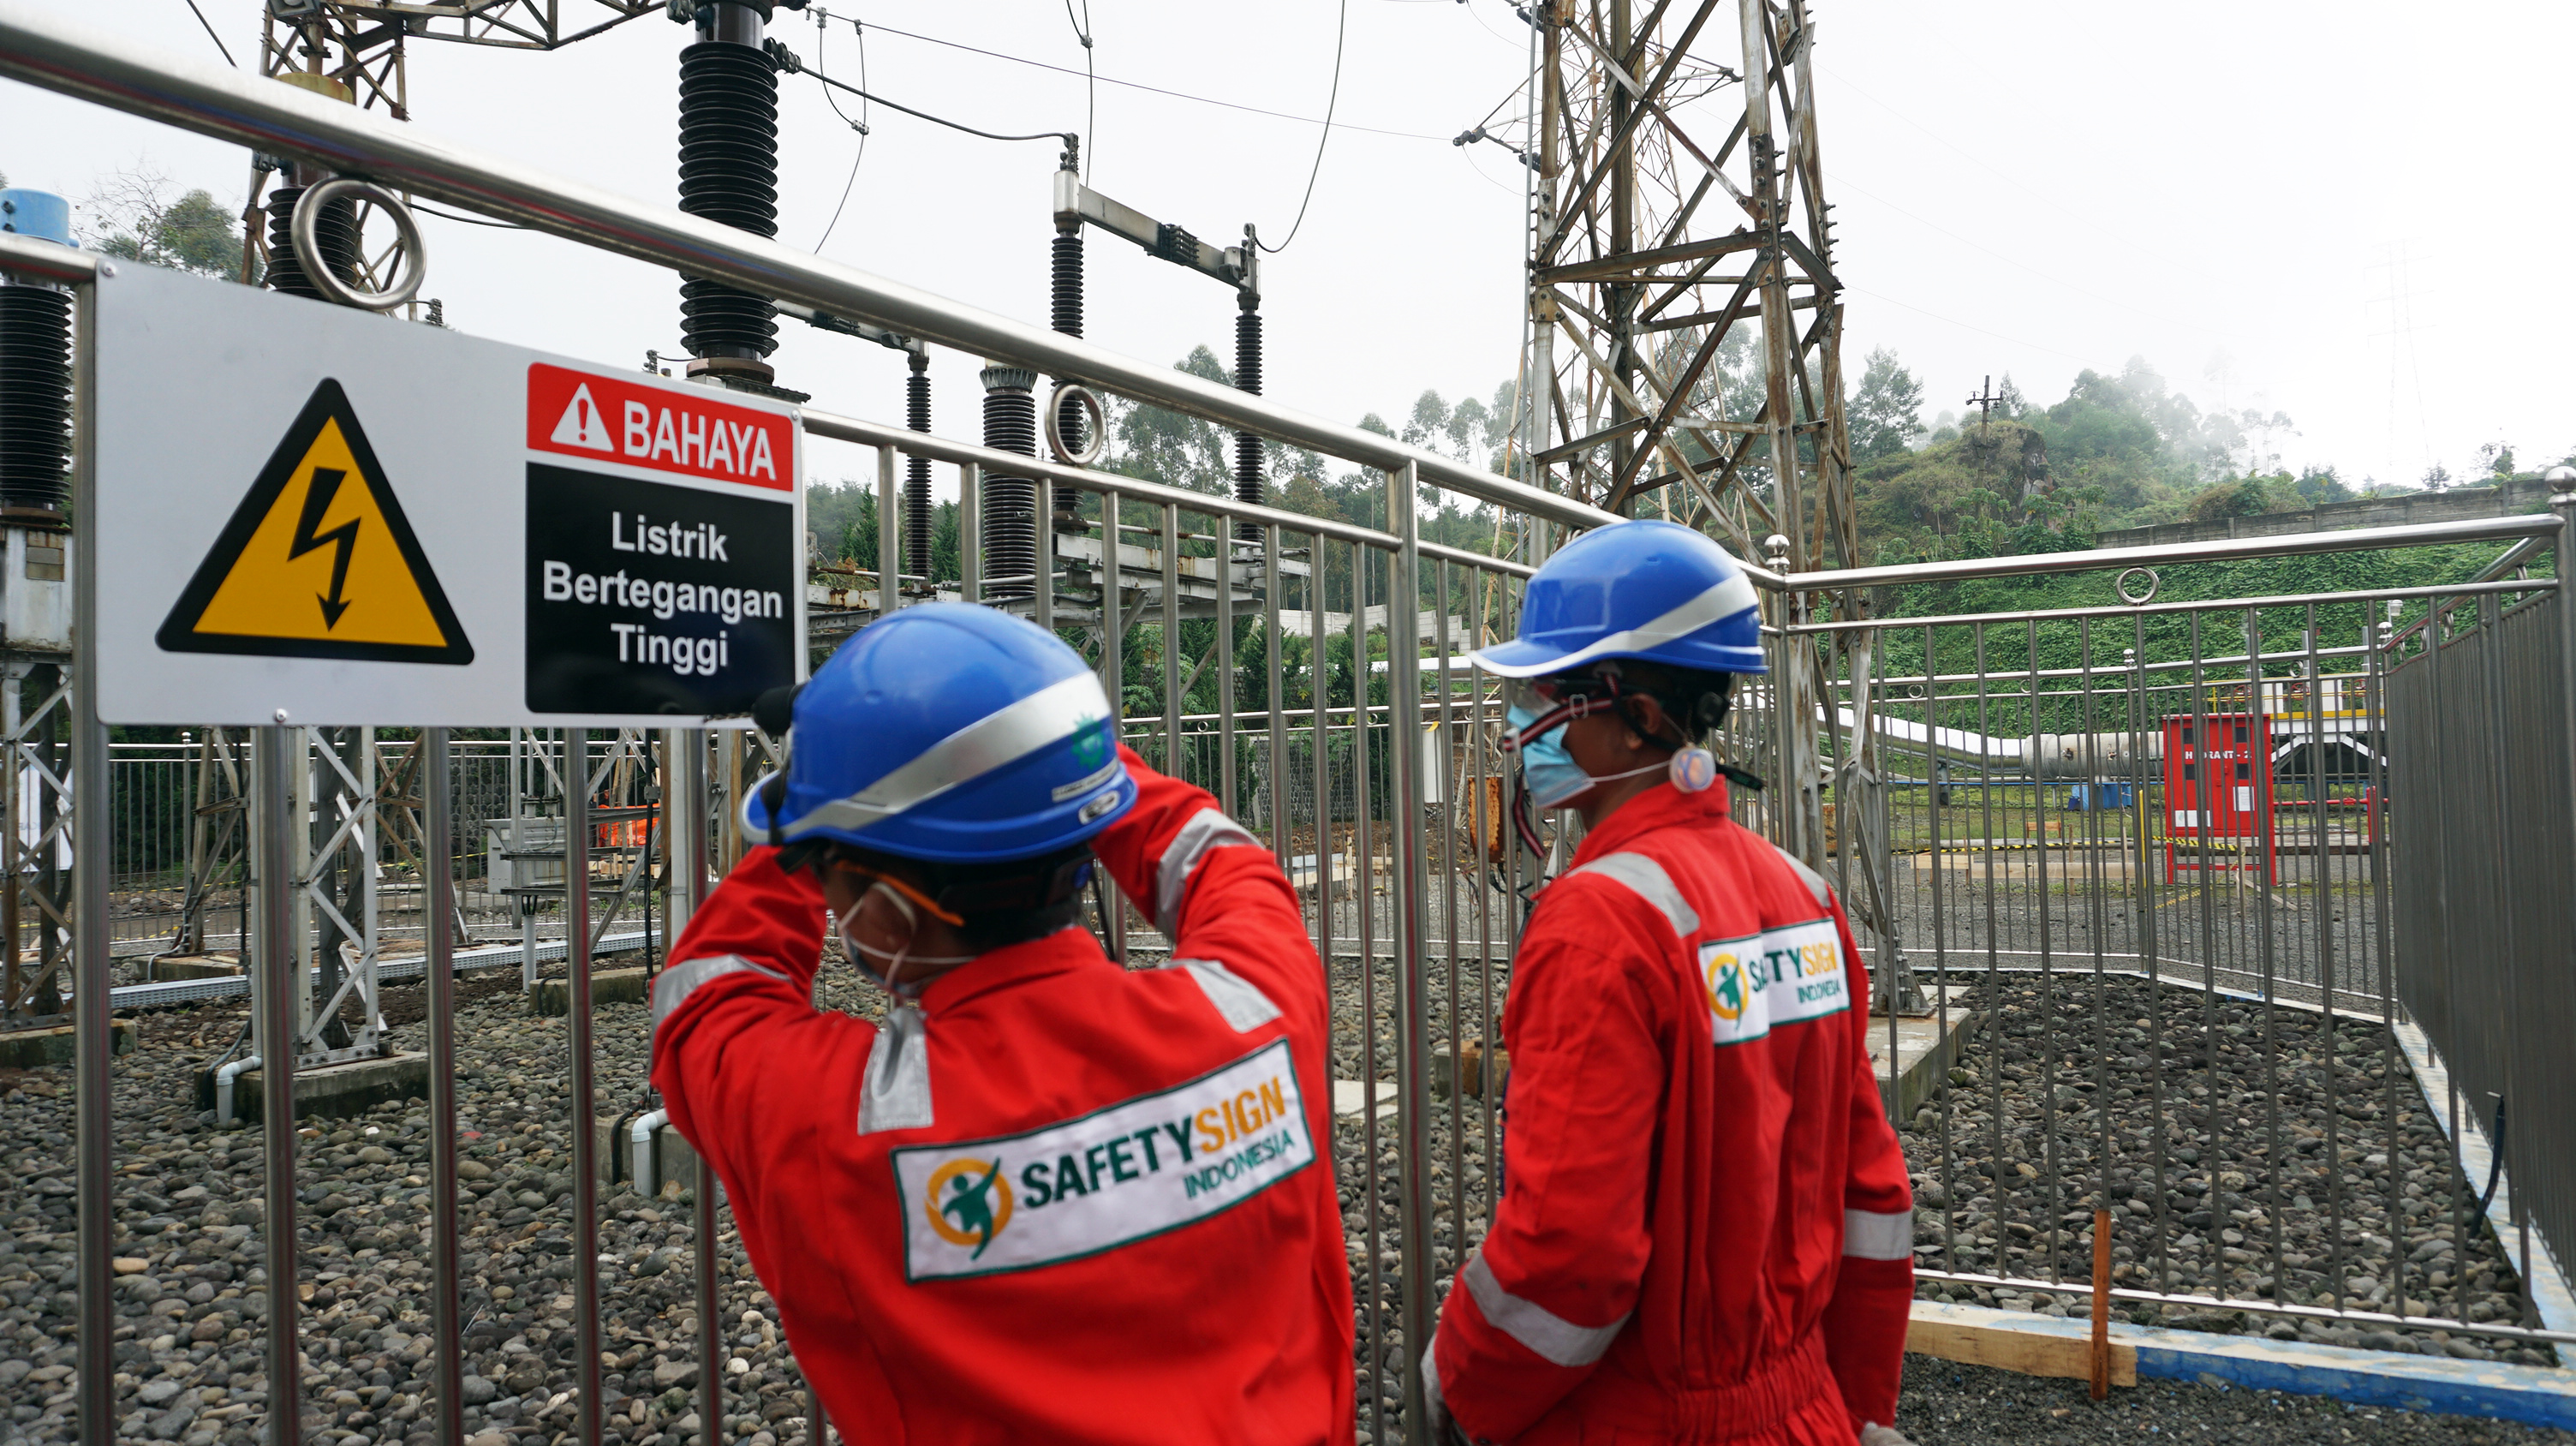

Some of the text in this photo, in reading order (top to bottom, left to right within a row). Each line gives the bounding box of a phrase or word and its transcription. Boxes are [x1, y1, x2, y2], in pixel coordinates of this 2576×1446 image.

[623, 399, 777, 481] BAHAYA
[612, 511, 728, 562] Listrik
[543, 560, 783, 625] Bertegangan
[610, 623, 728, 676] Tinggi
[1022, 1076, 1285, 1208] SAFETYSIGN
[1184, 1128, 1296, 1199] INDONESIA
